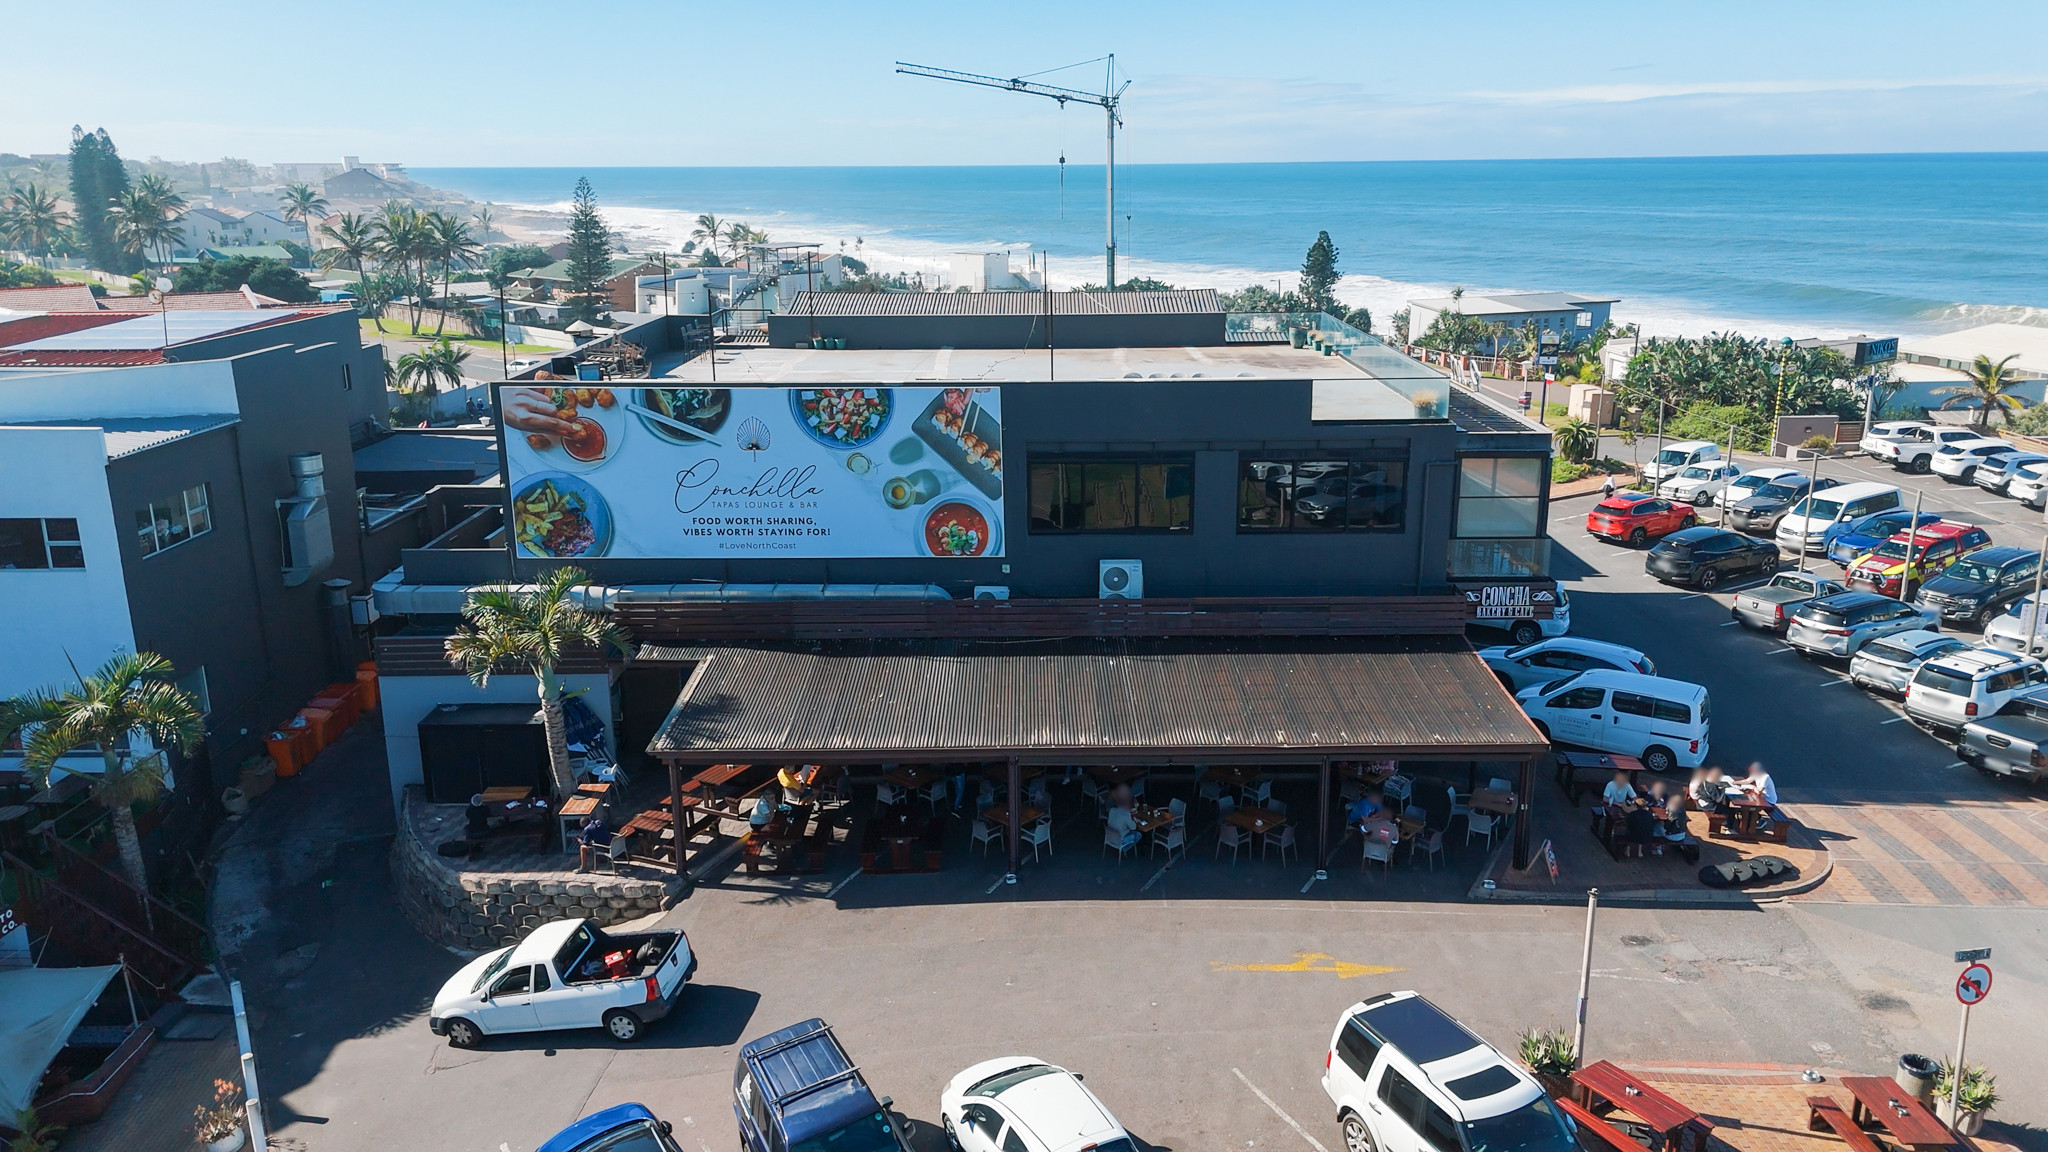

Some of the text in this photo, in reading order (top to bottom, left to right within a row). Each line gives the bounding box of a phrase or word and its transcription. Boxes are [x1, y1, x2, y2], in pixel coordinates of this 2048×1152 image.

[675, 458, 824, 514] Conchilla
[711, 501, 818, 509] TAPAS LOUNGE & BAR
[692, 517, 817, 526] FOOD WORTH SHARING,
[683, 528, 831, 536] VIBES WORTH STAYING FOR!
[719, 542, 796, 550] #LoveNorthCoast
[1481, 586, 1530, 606] CONCHA
[1477, 606, 1506, 618] BAKERY
[1507, 606, 1514, 618] &
[1, 920, 18, 935] CO.
